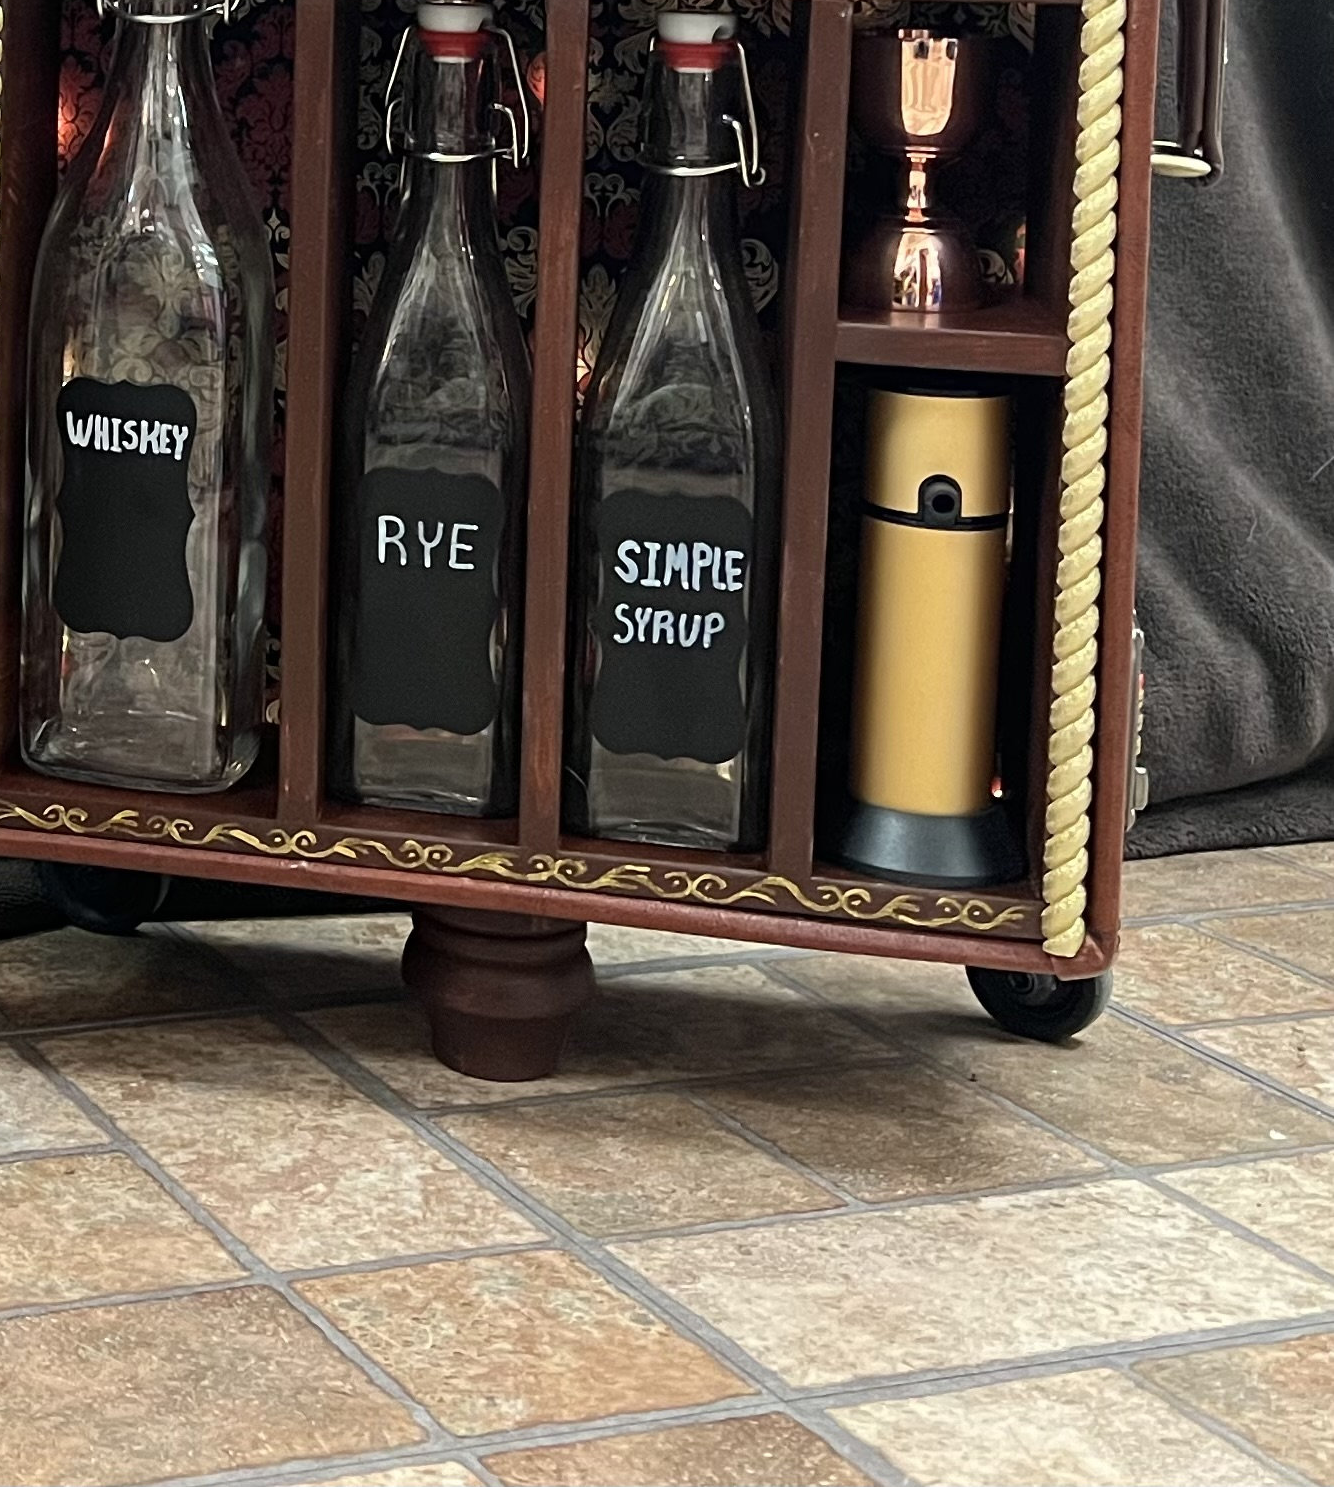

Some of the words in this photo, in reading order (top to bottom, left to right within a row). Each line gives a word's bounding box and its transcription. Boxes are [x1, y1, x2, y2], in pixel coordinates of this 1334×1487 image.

[66, 410, 189, 461] WHISKEY
[377, 514, 479, 570] RYE
[614, 539, 745, 593] SIMPLE
[613, 603, 726, 649] SYRUP
